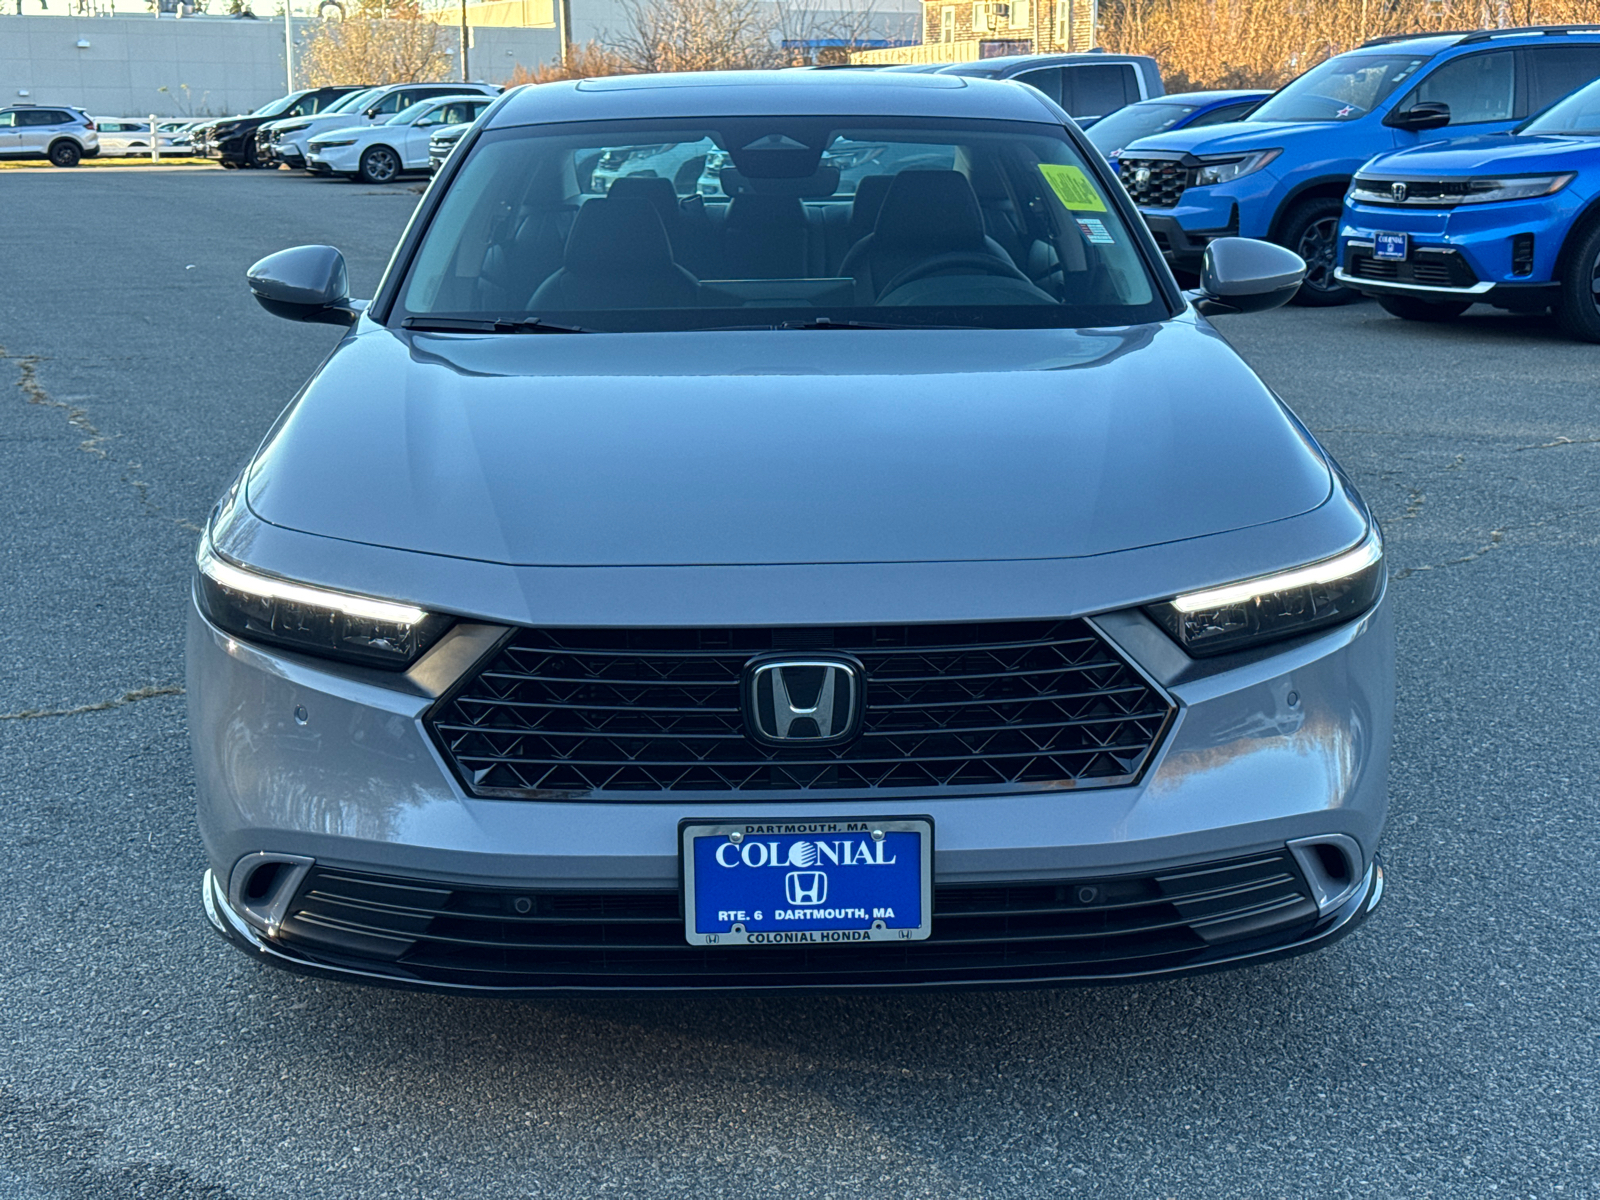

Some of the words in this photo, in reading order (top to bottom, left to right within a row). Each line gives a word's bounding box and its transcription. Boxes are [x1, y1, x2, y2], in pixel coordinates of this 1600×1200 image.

[745, 823, 842, 834] DARTMOUTH,
[846, 823, 869, 831] MA
[715, 839, 897, 868] COLONIAL
[718, 910, 751, 921] RTE.
[754, 911, 763, 921] 6
[774, 908, 870, 921] DARTMOUTH,
[872, 907, 895, 919] MA
[747, 933, 817, 944] COLONIAL
[820, 931, 871, 942] HONDA
